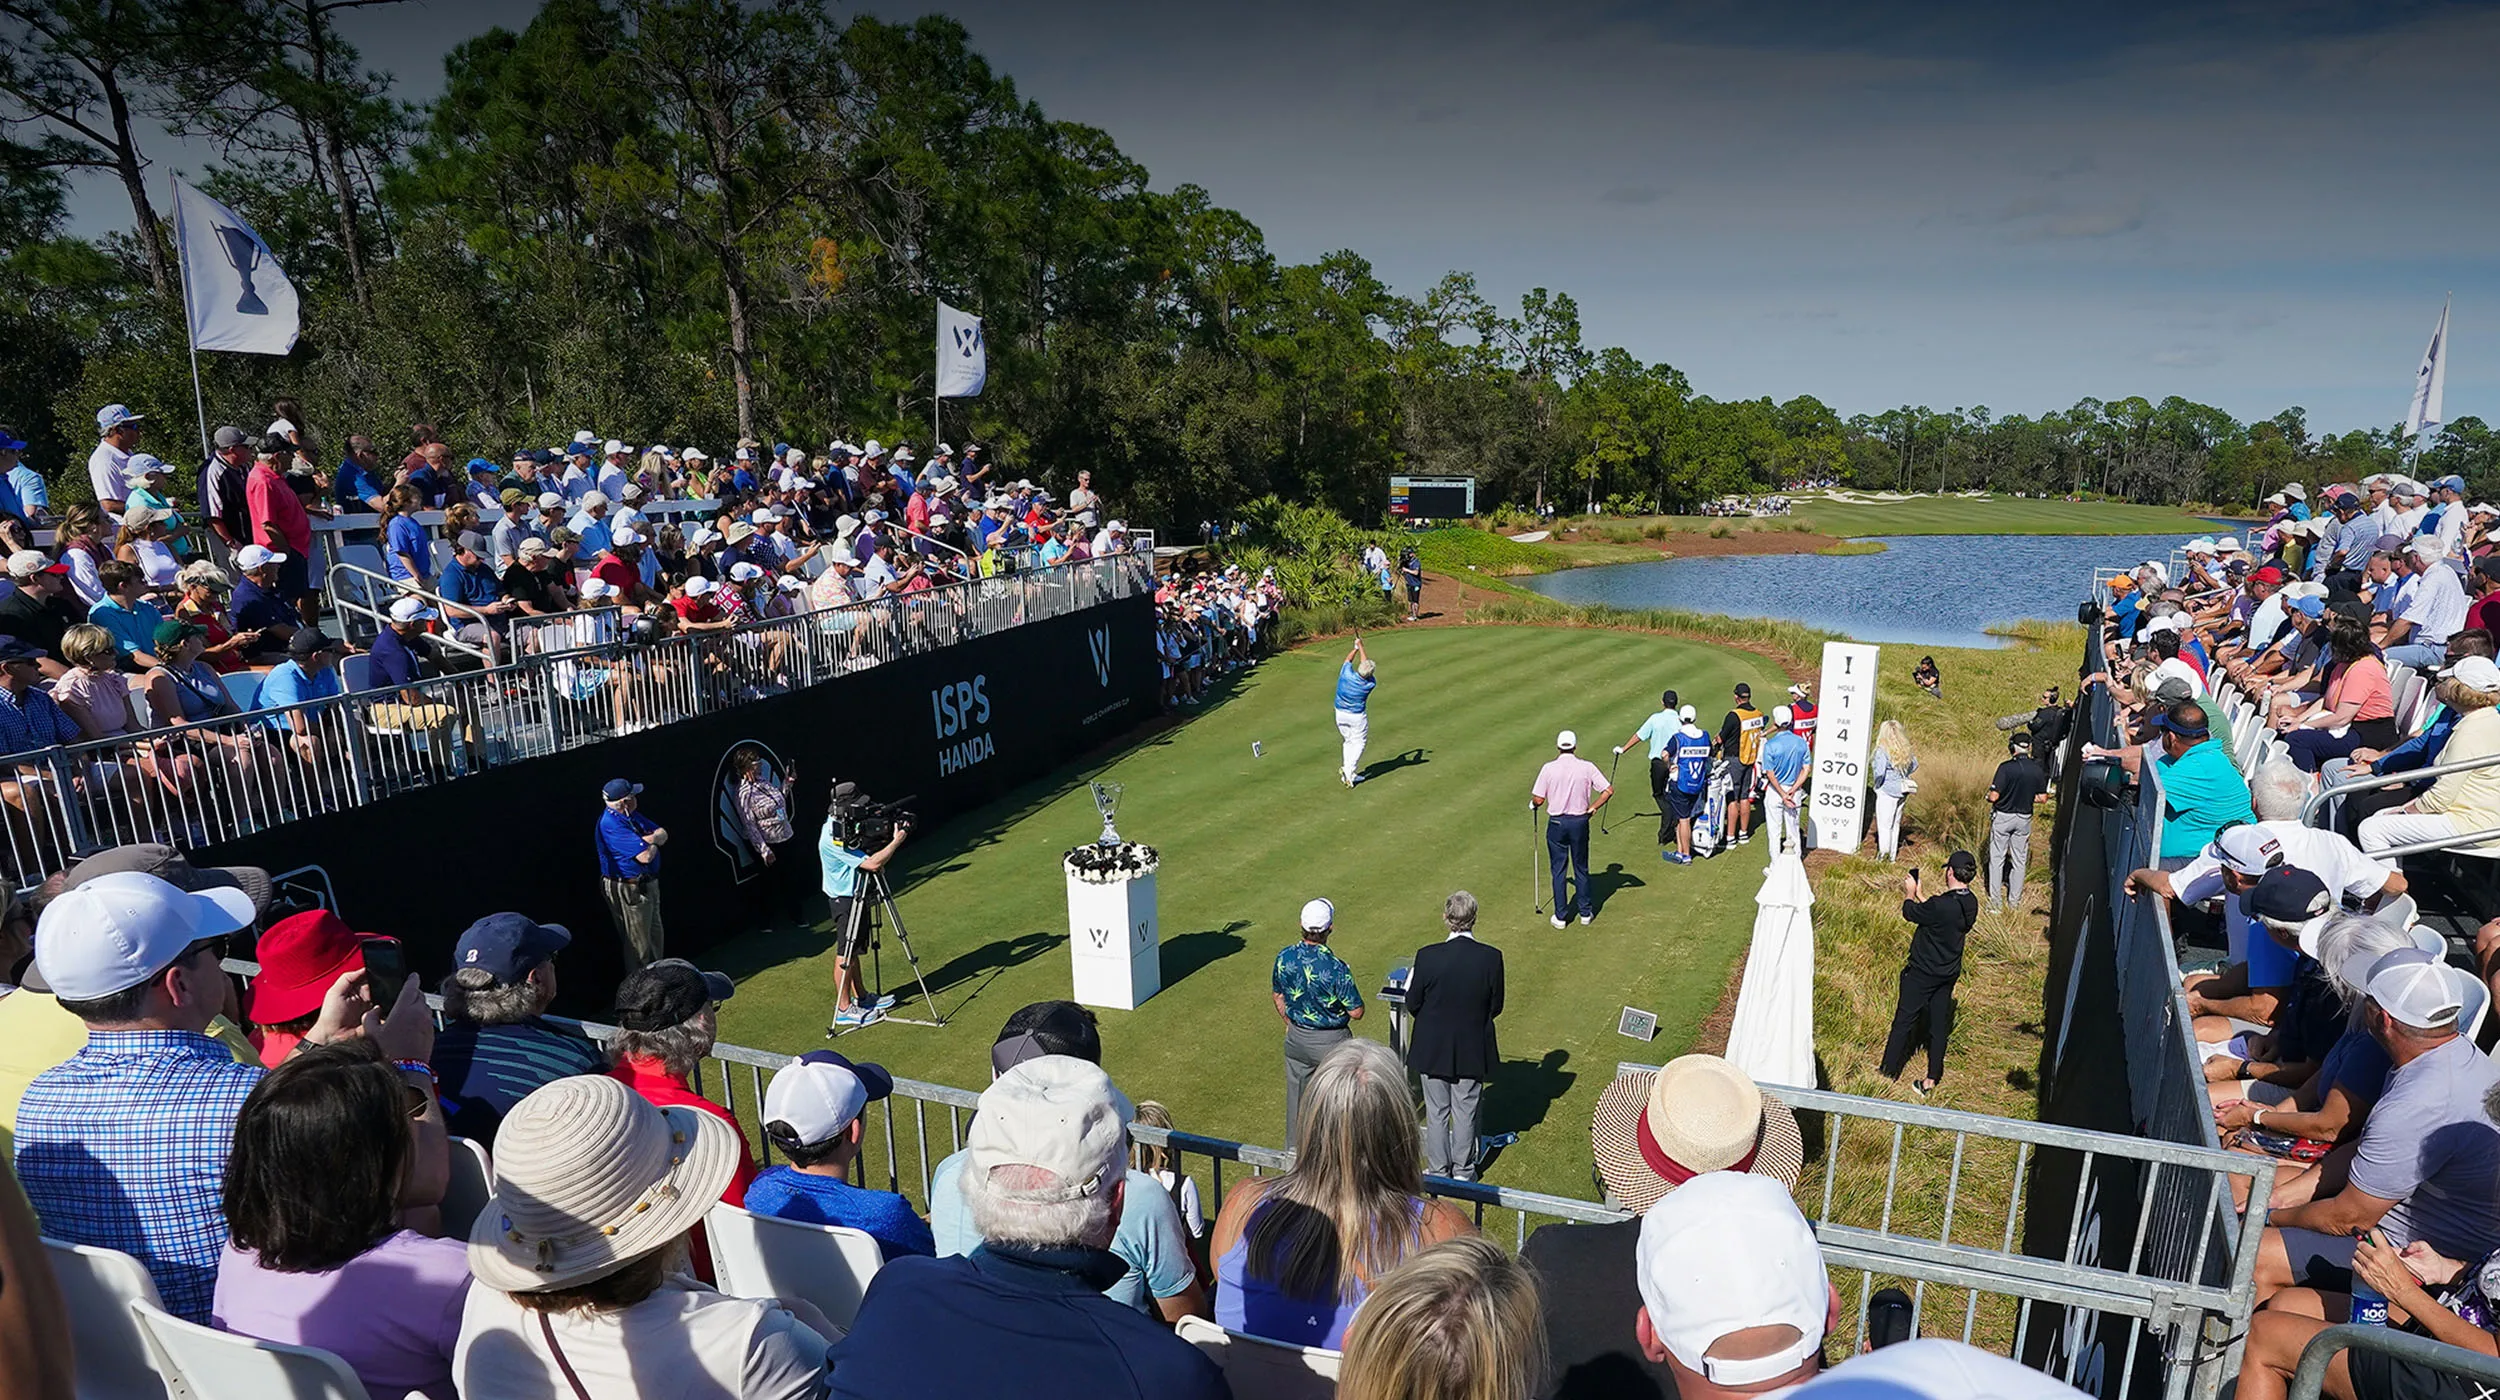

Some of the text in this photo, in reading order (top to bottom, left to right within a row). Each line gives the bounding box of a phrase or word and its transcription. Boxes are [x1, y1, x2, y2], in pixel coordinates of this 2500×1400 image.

[931, 674, 990, 740] ISPS
[1842, 695, 1849, 708] 1
[1836, 728, 1848, 742] 4
[939, 732, 995, 778] HANDA
[1822, 760, 1858, 776] 370
[1824, 783, 1852, 792] METERS
[1818, 792, 1856, 809] 338
